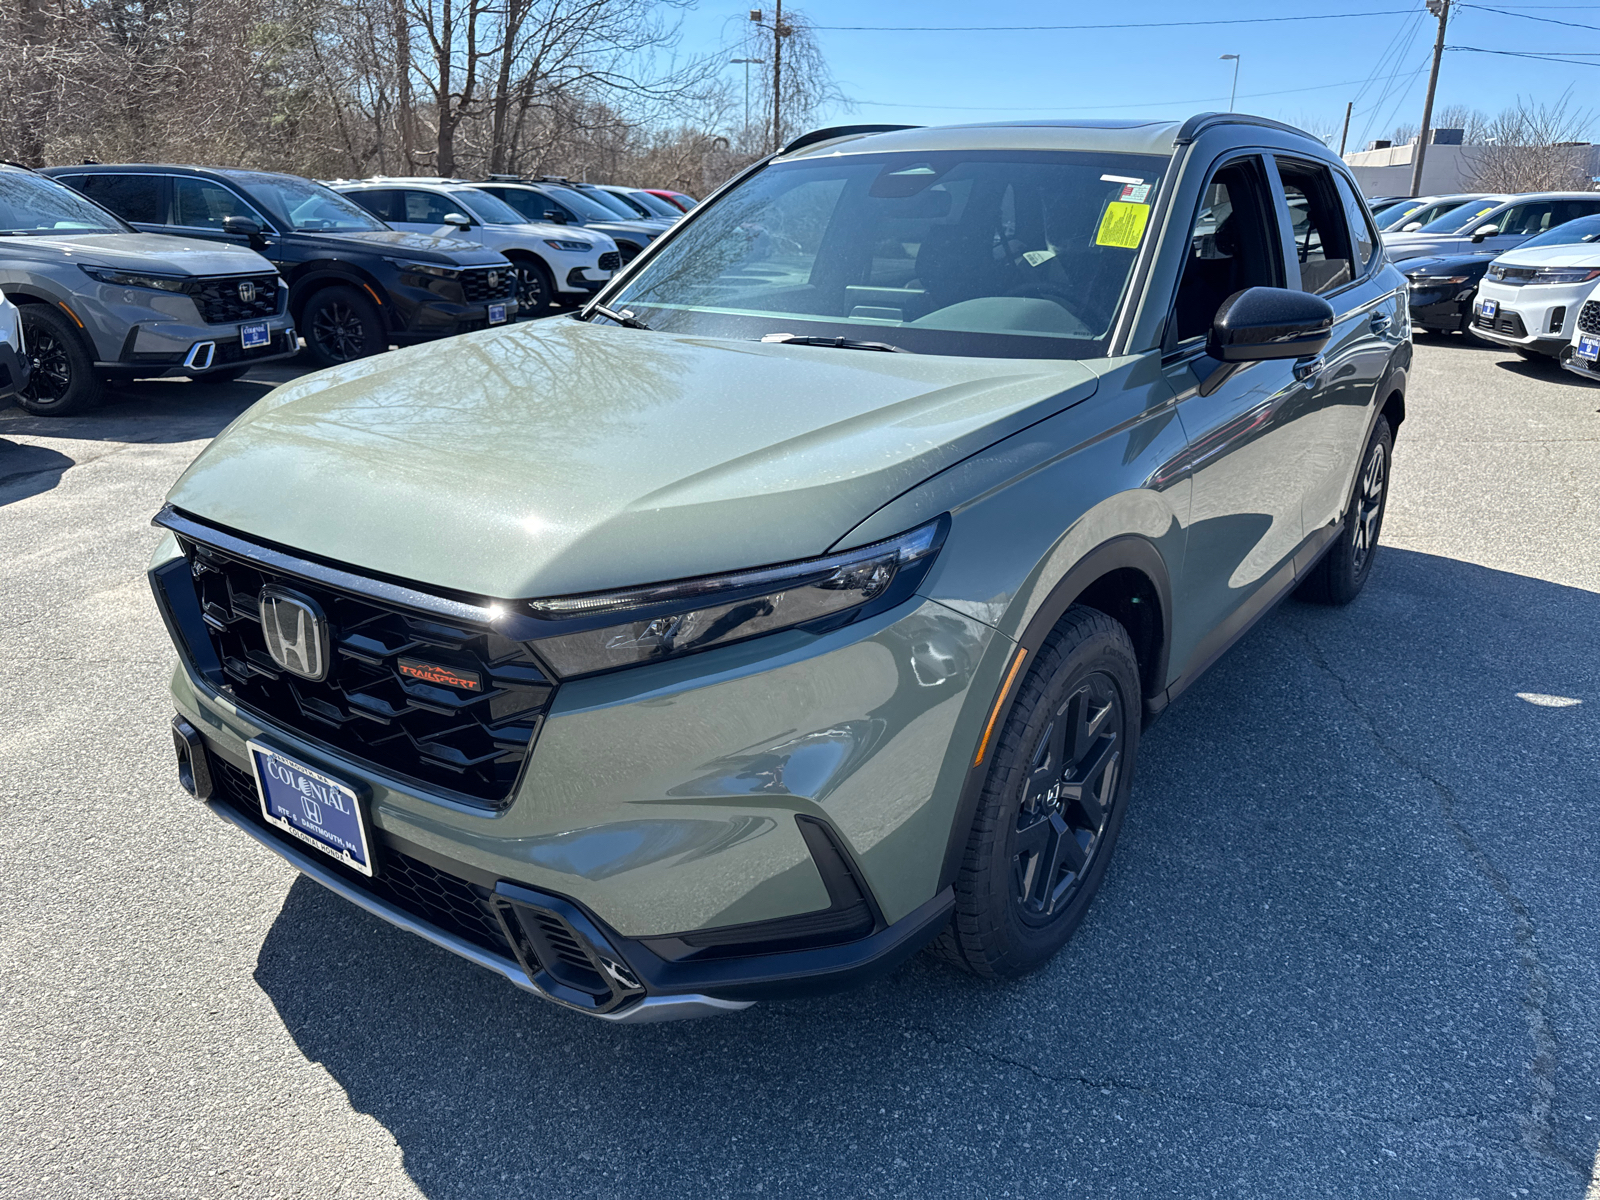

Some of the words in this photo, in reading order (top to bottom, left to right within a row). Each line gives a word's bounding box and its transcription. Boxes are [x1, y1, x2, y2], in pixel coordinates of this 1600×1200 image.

[400, 665, 477, 689] TRAILSPORT
[267, 762, 349, 815] COLONIAL
[277, 805, 292, 819] RTE.
[292, 813, 298, 821] 6
[301, 818, 345, 848] DARTMOUTH,
[345, 840, 357, 853] MA
[288, 827, 320, 849] COLONIAL
[321, 845, 344, 862] HONDA
